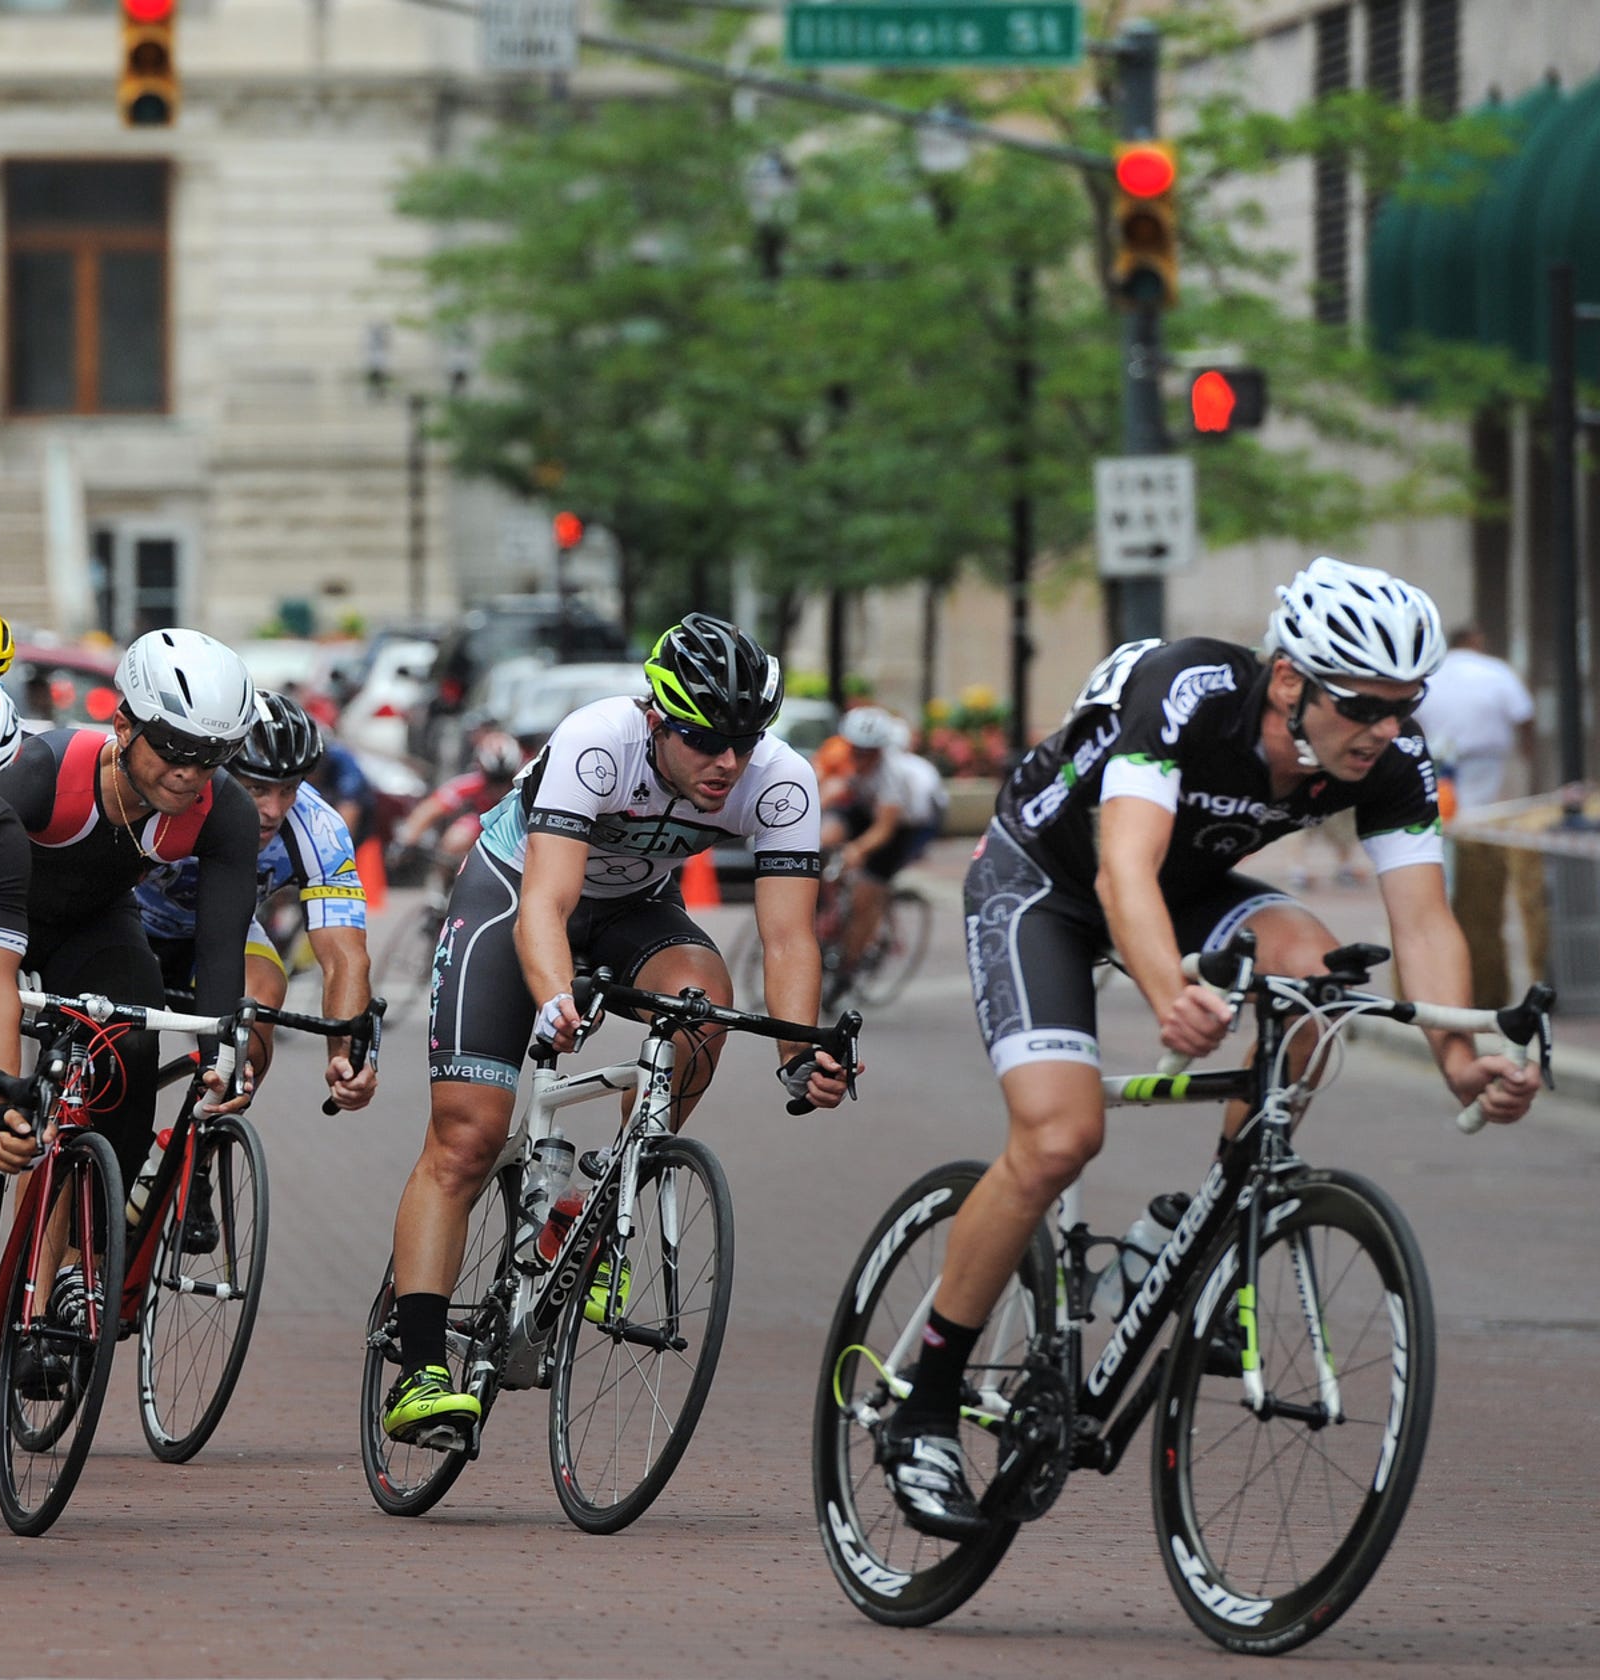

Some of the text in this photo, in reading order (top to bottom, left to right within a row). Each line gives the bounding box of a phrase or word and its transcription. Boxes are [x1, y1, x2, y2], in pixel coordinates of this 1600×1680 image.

[794, 12, 1064, 55] Illinois St
[201, 717, 231, 729] GIRO
[1087, 1161, 1228, 1396] cannondale
